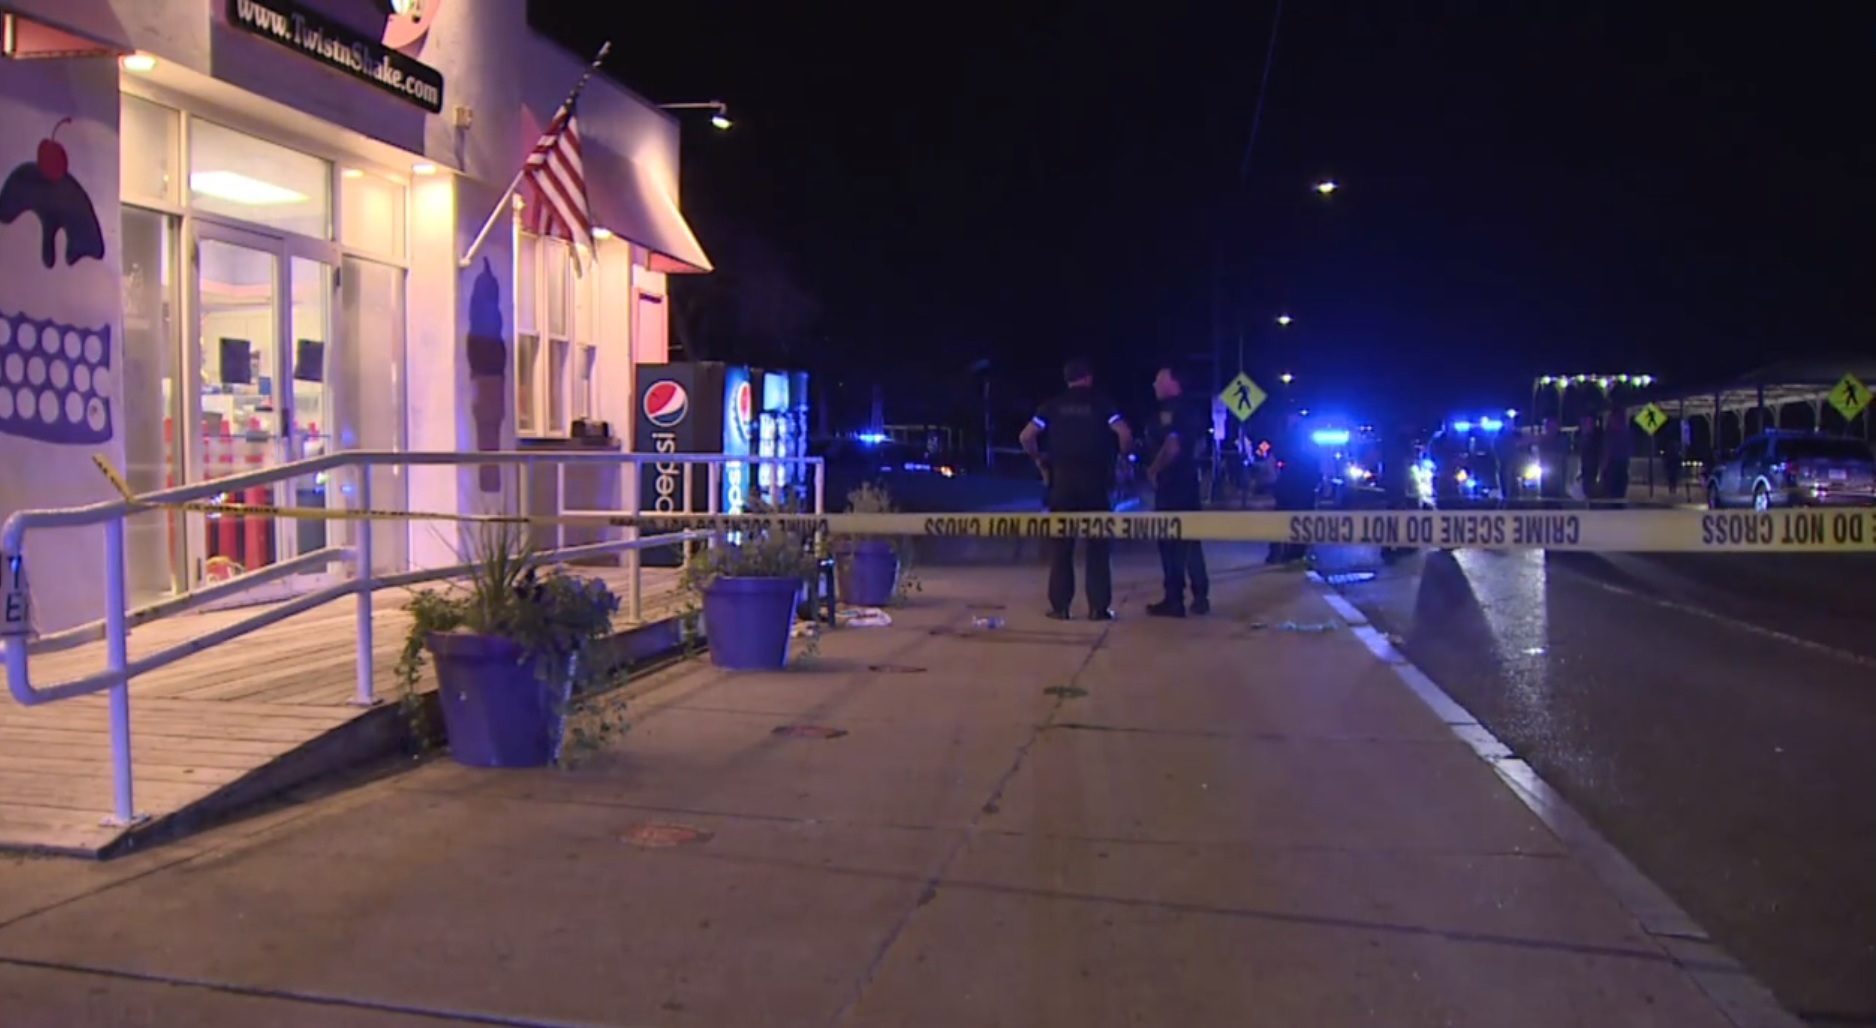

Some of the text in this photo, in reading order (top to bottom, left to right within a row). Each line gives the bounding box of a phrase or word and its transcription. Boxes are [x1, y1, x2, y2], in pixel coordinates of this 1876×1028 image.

[237, 0, 438, 105] www.TwistnShake.com
[1057, 517, 1116, 538] SCENE
[1121, 517, 1182, 539] CRIME
[1289, 515, 1580, 544] CRIME SCENE DO NOT CROSS
[1702, 513, 1774, 544] CROSS
[1781, 513, 1820, 544] NOT
[1833, 513, 1863, 543] DO
